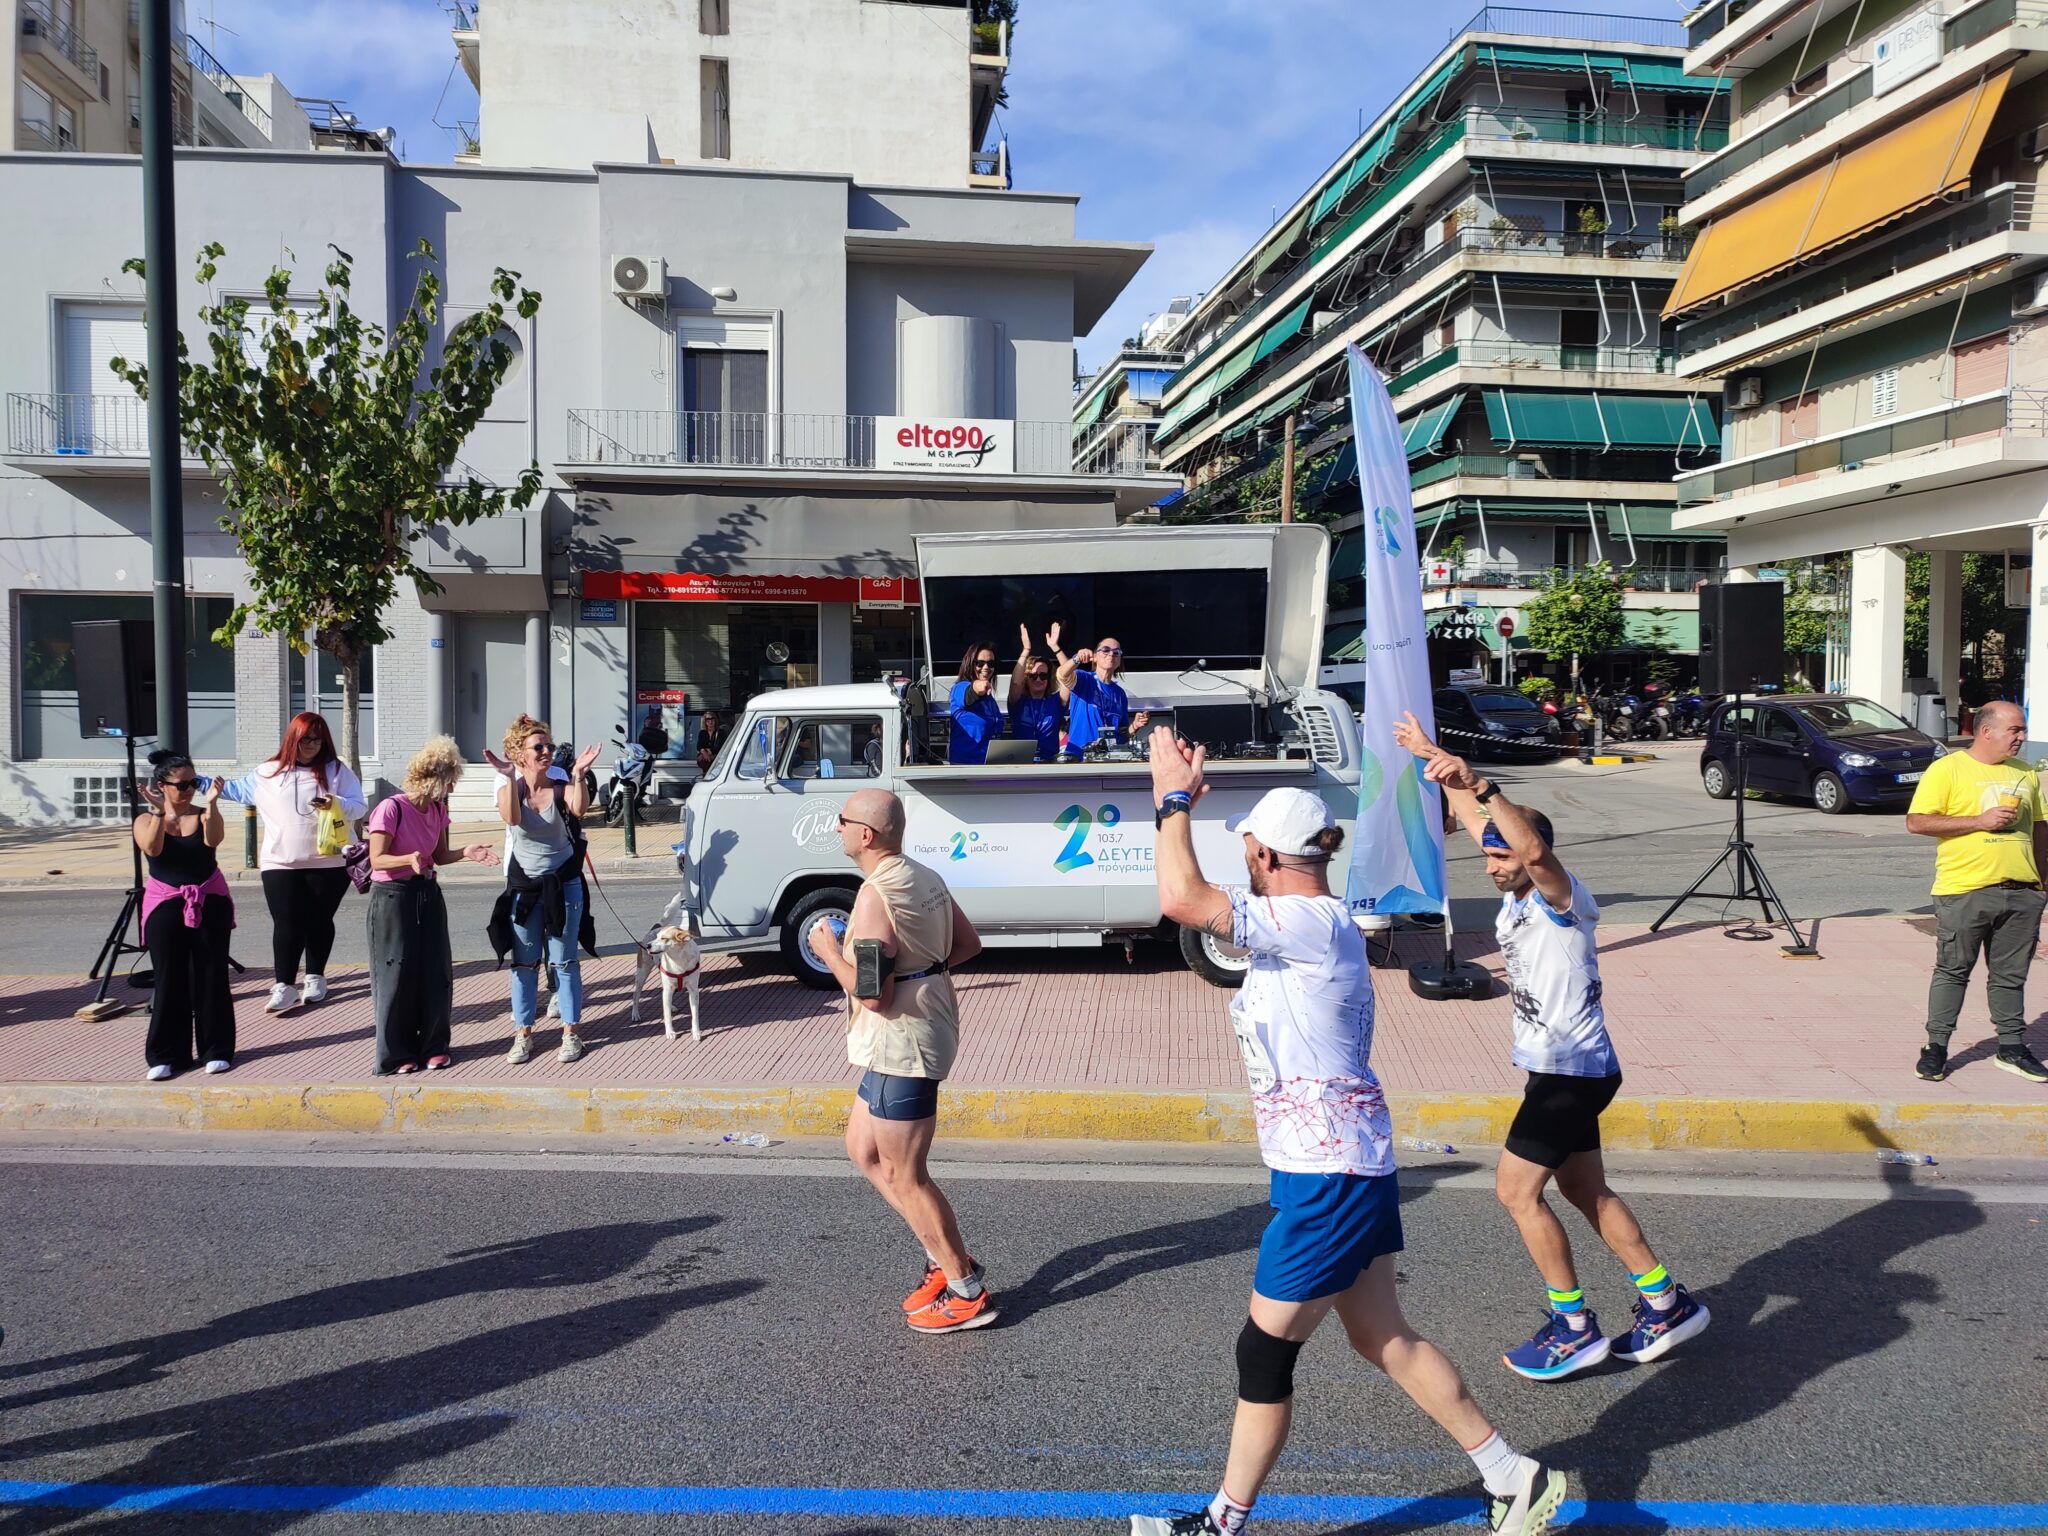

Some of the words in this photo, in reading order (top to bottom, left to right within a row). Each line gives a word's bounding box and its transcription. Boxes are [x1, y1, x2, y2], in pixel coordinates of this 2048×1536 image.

[897, 423, 983, 449] elta90
[872, 579, 892, 587] GAS
[647, 586, 662, 595] Τηλ.
[1097, 833, 1124, 843] 103.7
[914, 843, 938, 855] Πάρε
[939, 845, 950, 853] το
[970, 842, 989, 854] μαζί
[991, 844, 1009, 852] σου
[1098, 847, 1153, 861] ΔΕΥΤΕ
